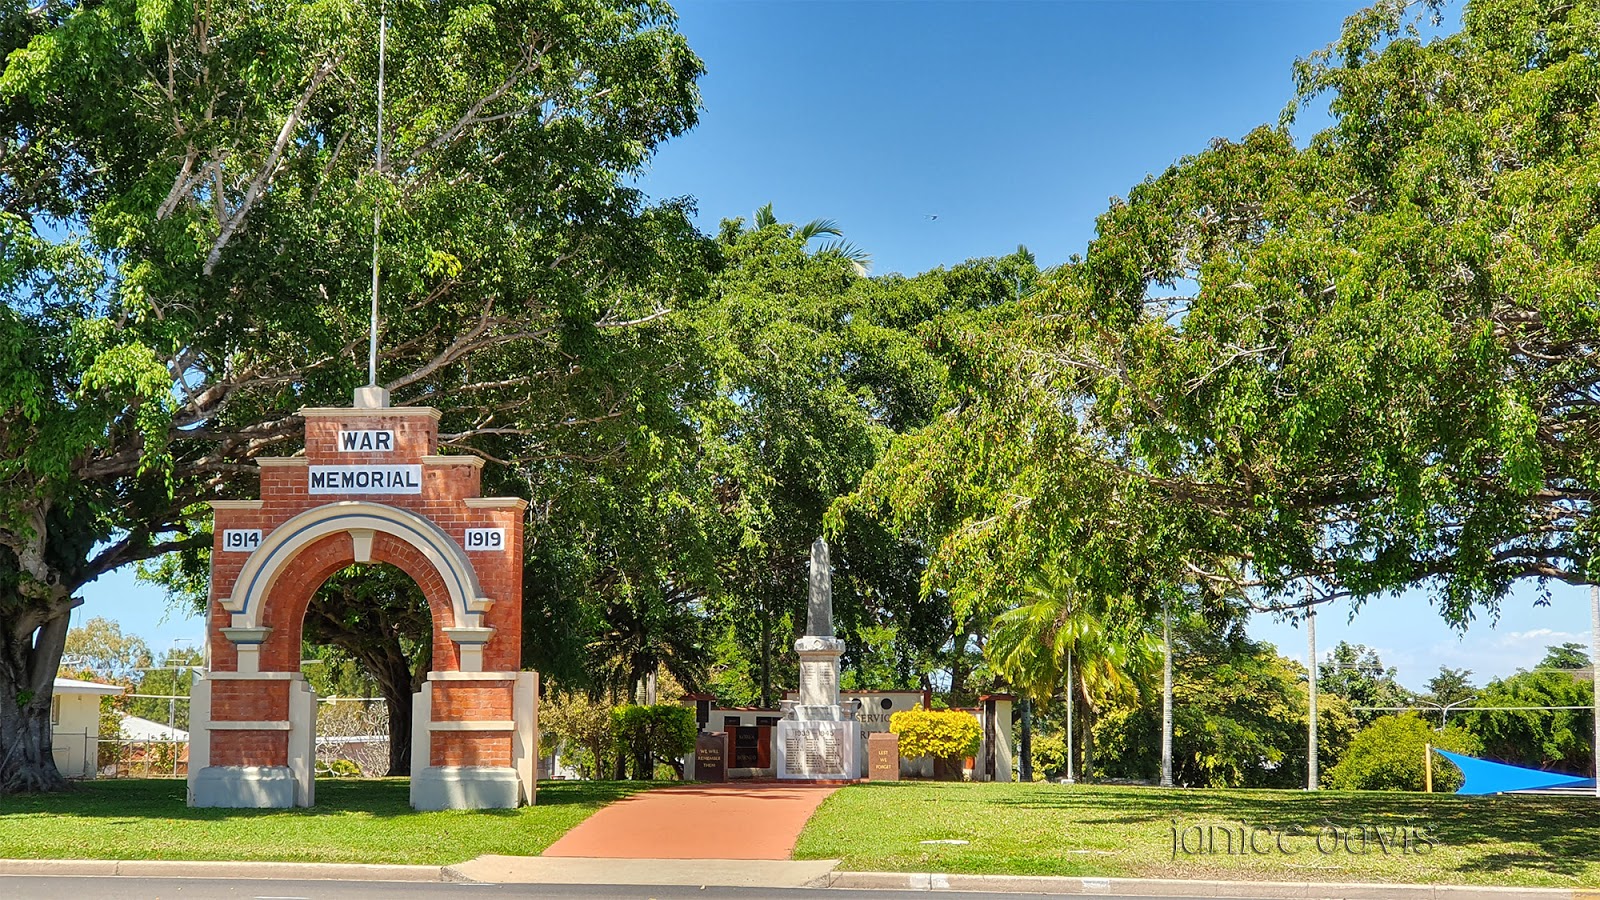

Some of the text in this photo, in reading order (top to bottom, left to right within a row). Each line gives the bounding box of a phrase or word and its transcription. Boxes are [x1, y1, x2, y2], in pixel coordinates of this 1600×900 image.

[342, 431, 391, 451] WAR
[311, 470, 419, 489] MEMORIAL
[227, 532, 259, 548] 1914
[467, 531, 501, 547] 1919
[855, 713, 891, 723] SERVIC
